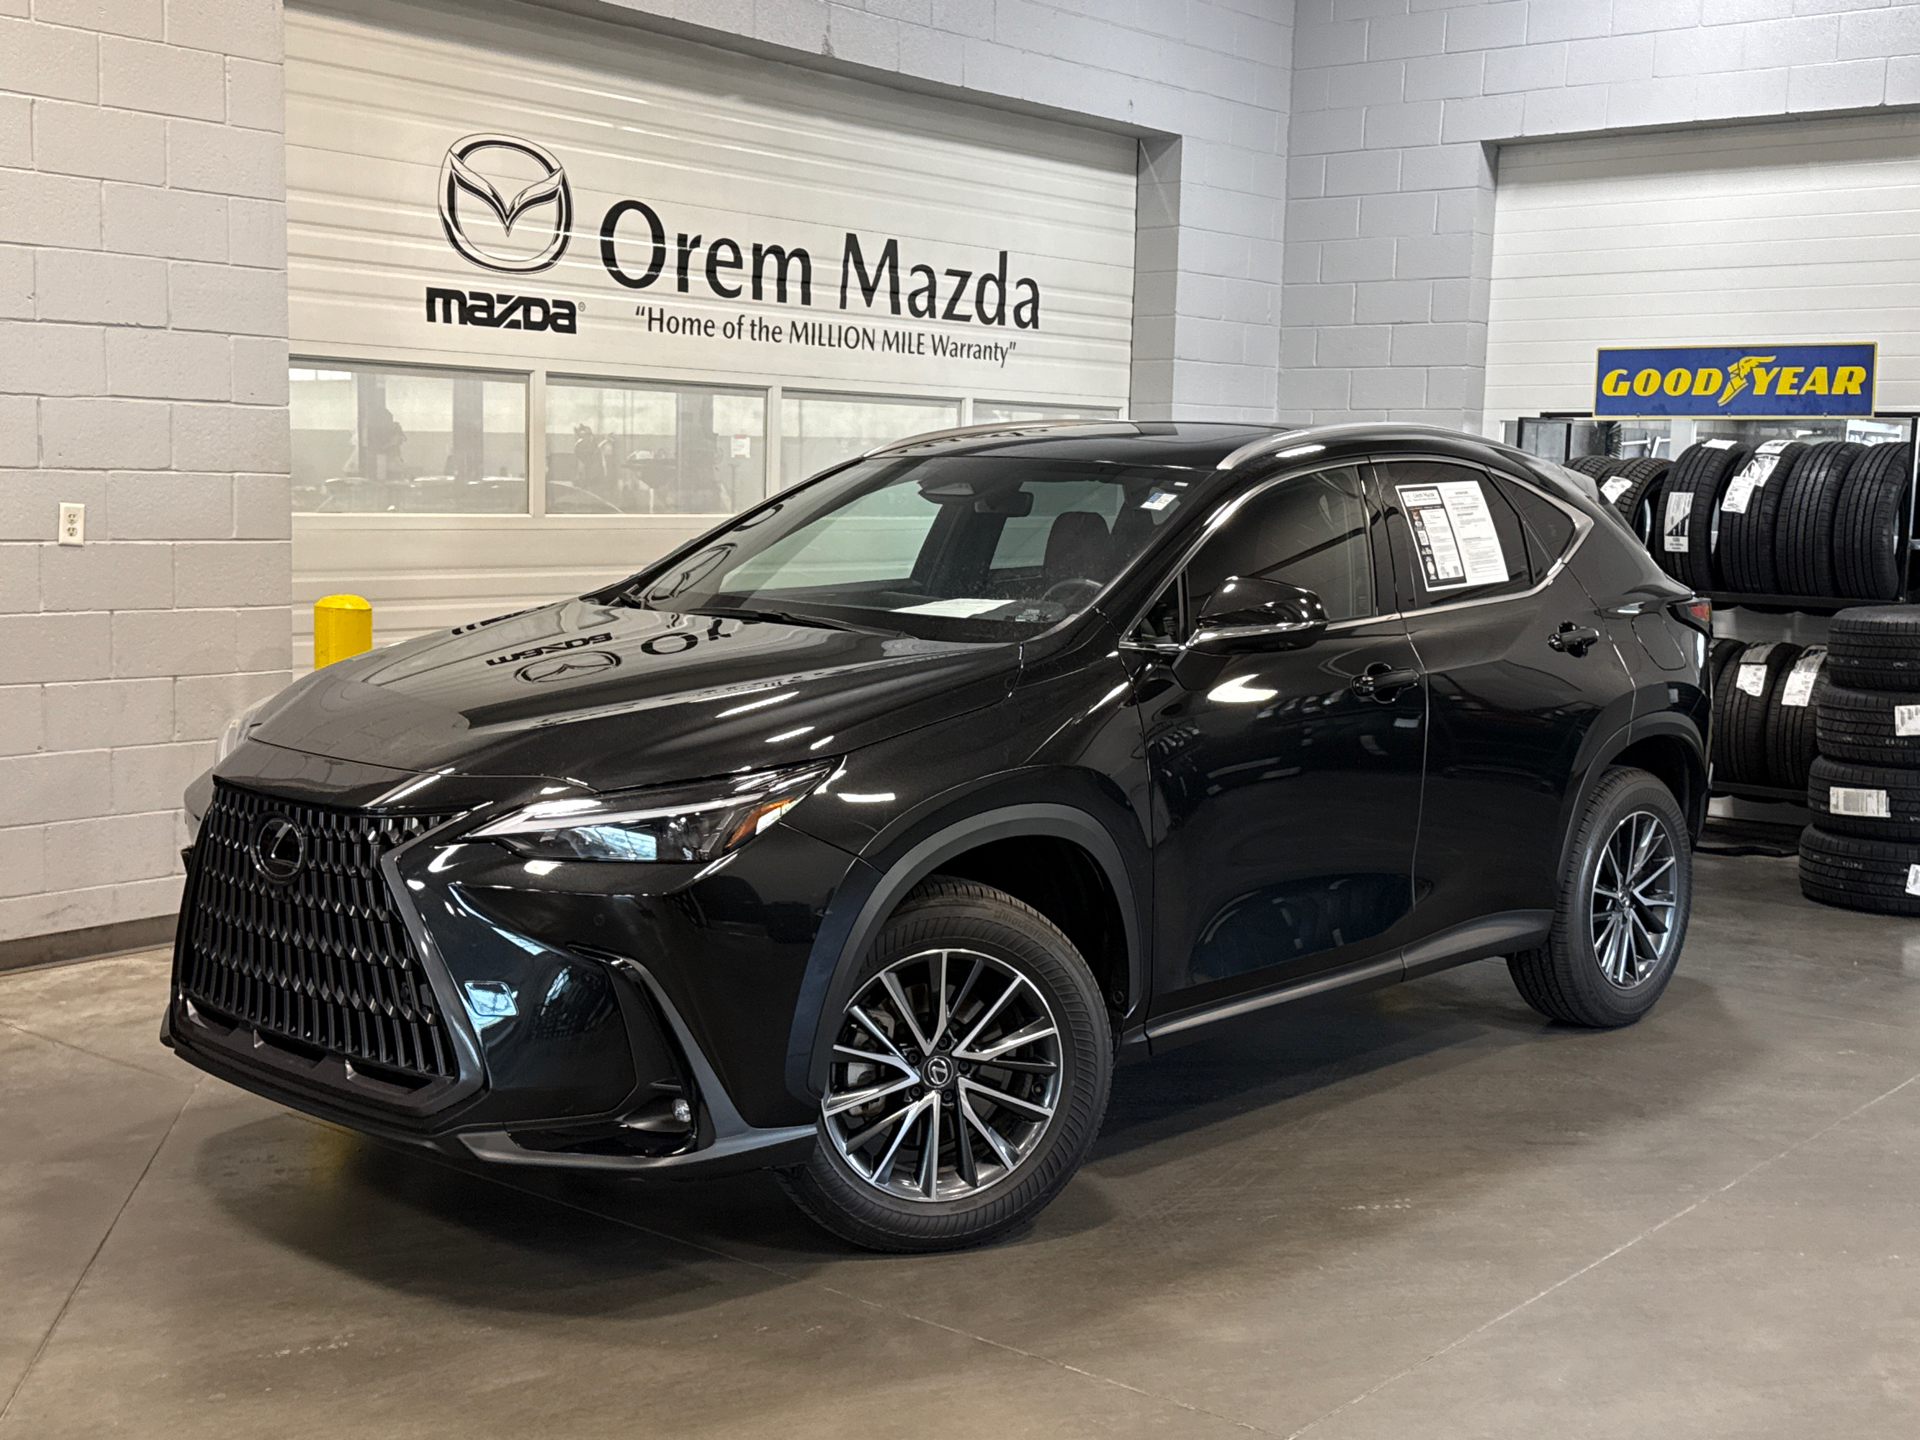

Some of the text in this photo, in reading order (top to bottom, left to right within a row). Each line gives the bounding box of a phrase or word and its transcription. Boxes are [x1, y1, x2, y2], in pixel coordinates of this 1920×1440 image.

[600, 200, 1040, 330] Orem Mazda
[426, 287, 577, 334] mazda
[723, 314, 745, 340] of
[750, 316, 783, 343] the
[789, 320, 876, 351] MILLION
[881, 329, 925, 356] MILE
